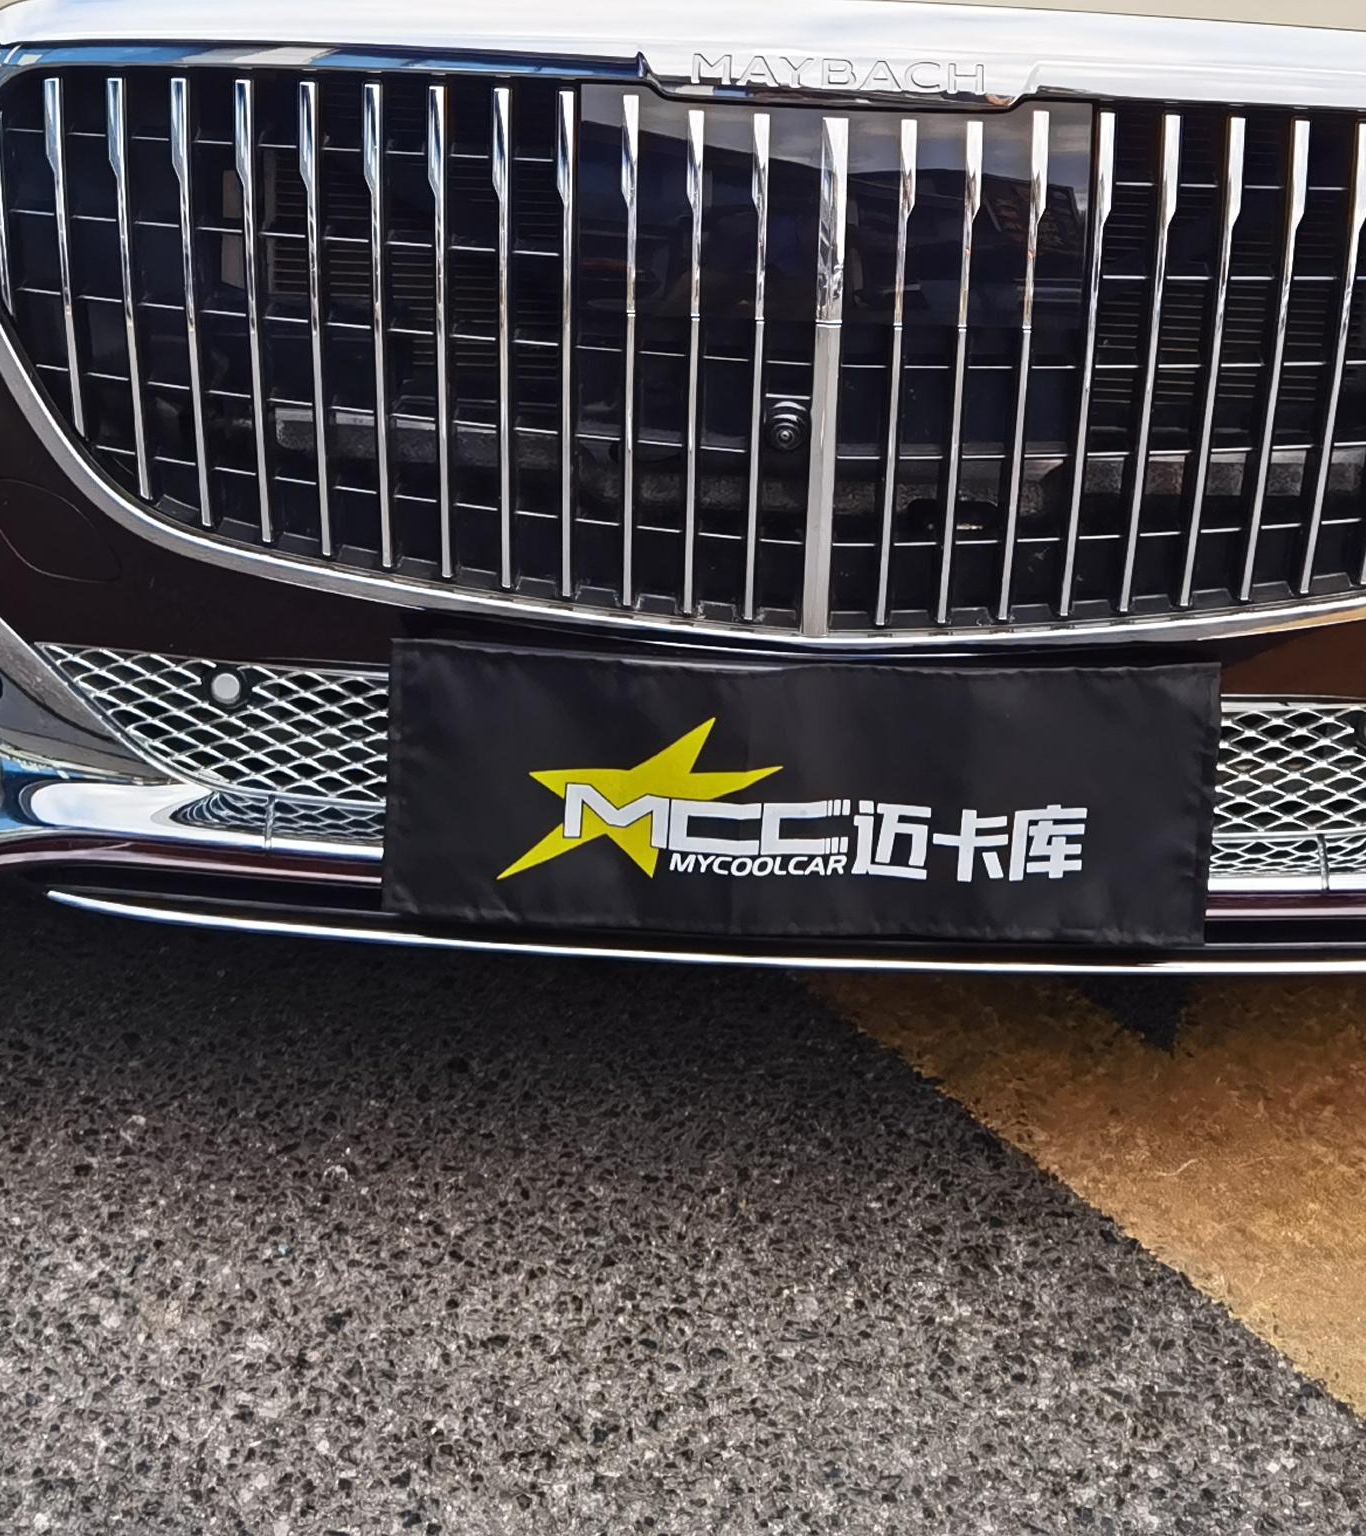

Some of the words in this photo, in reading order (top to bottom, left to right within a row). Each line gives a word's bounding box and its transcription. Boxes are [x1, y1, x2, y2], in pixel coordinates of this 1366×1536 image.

[690, 52, 987, 96] MAYBACH
[851, 799, 1088, 884] 迈卡库
[668, 854, 846, 877] MYCOOLCAR
